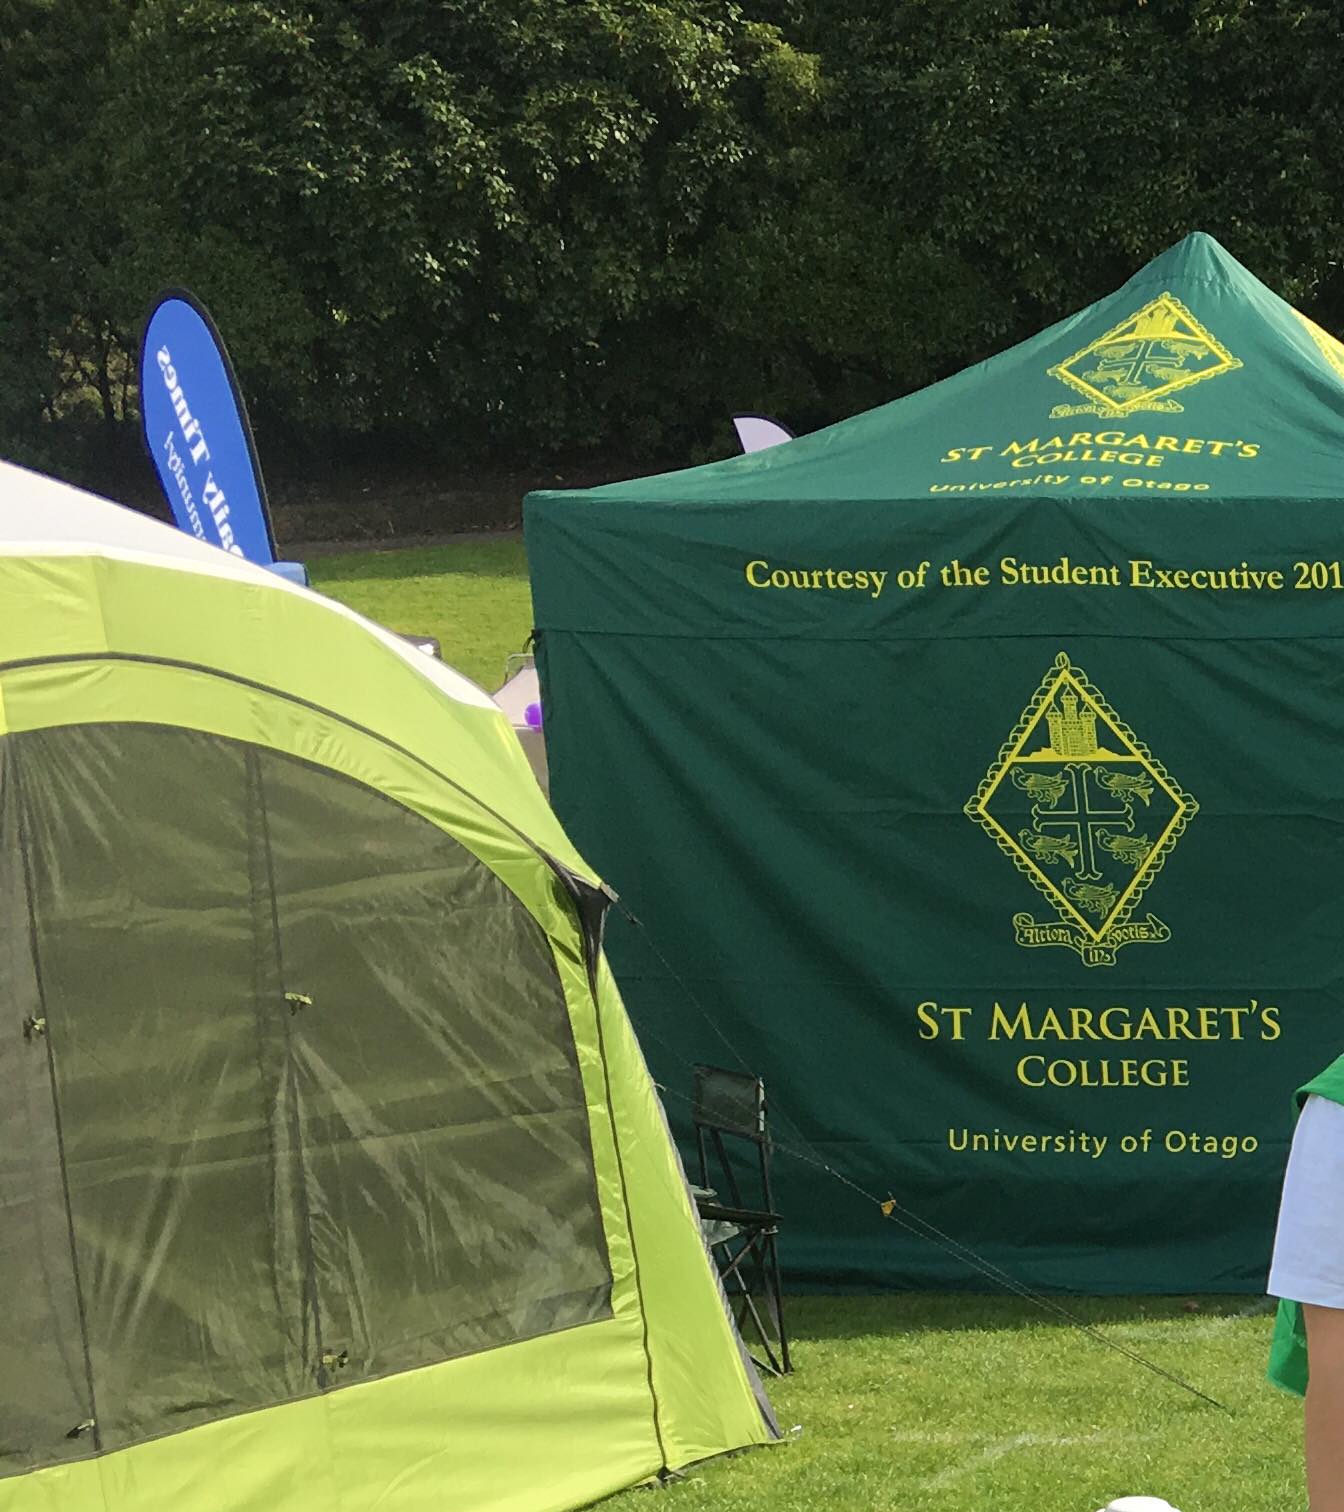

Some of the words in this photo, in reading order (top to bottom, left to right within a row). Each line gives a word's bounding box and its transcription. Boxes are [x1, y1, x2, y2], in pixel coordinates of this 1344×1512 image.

[940, 447, 993, 463] ST
[1001, 431, 1261, 458] MARGARET'S
[1010, 449, 1165, 468] COLLEGE
[929, 473, 1071, 493] University
[1079, 474, 1114, 485] of
[1122, 478, 1211, 491] Otago
[745, 559, 885, 598] Courtesy
[897, 560, 931, 588] of
[940, 560, 990, 587] the
[1000, 557, 1121, 588] Student
[1129, 560, 1284, 590] Executive
[916, 1002, 972, 1040] ST
[988, 999, 1282, 1041] MARGARET'S
[1016, 1055, 1190, 1087] COLLEGE
[948, 1129, 1107, 1159] University
[1120, 1128, 1152, 1153] of
[1164, 1130, 1259, 1158] Otago
